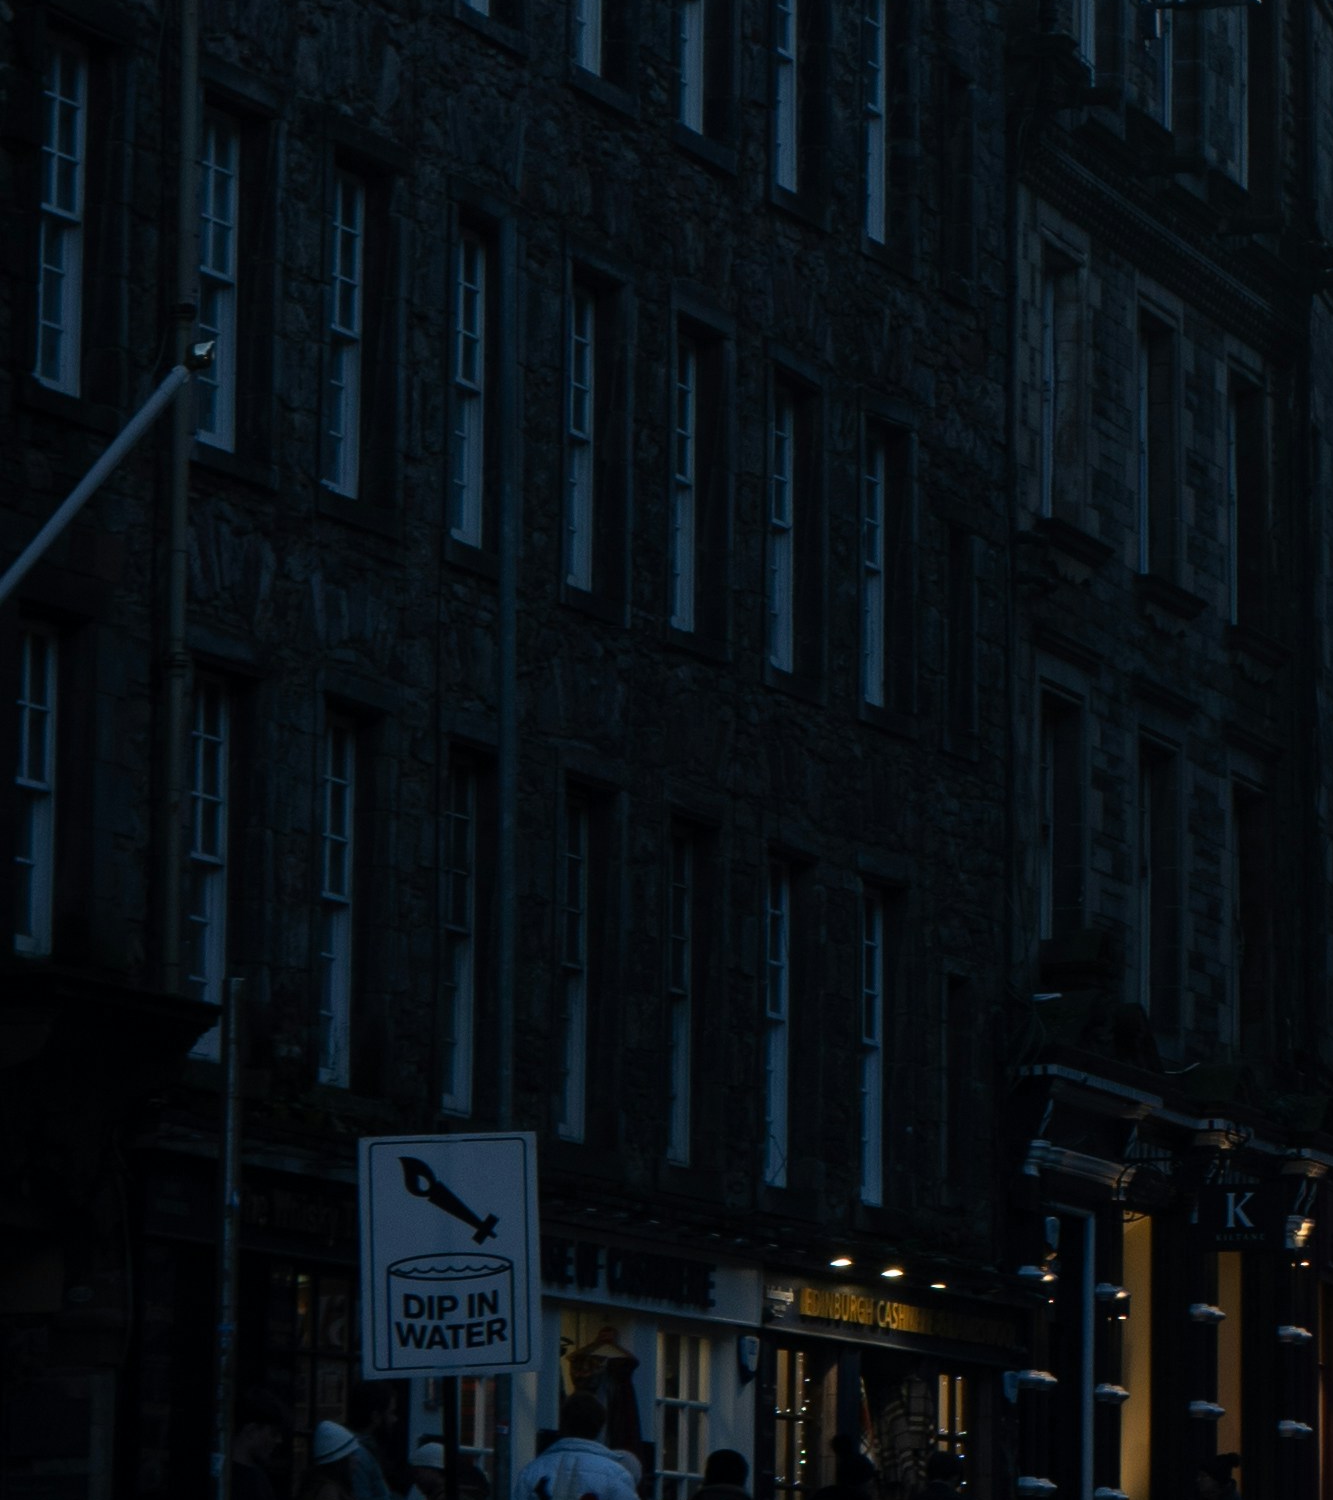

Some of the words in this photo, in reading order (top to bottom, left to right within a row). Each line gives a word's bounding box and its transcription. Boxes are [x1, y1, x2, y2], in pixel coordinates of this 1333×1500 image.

[1225, 1191, 1256, 1228] K
[1215, 1233, 1266, 1241] KILTANE
[403, 1293, 459, 1321] DIP
[467, 1289, 499, 1319] IN
[800, 1287, 874, 1326] EDINBURGH
[395, 1318, 507, 1350] WATER
